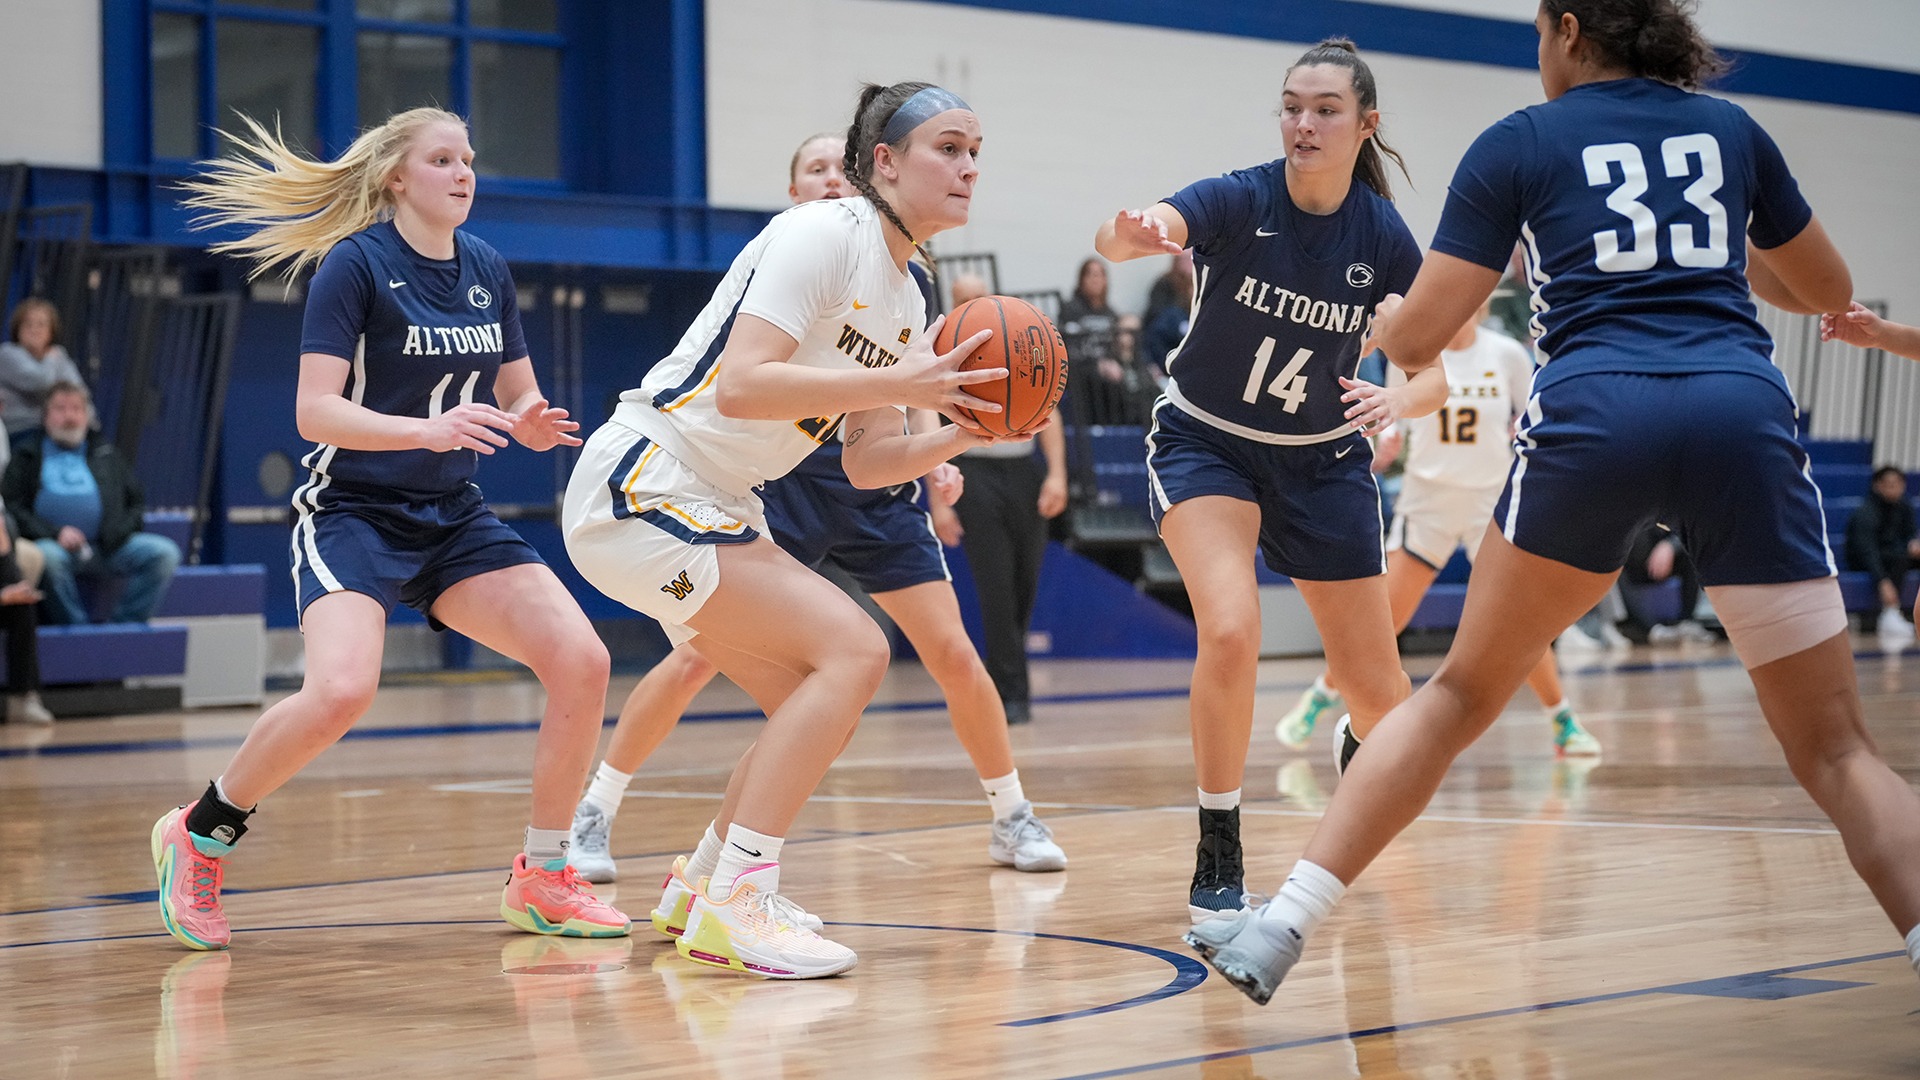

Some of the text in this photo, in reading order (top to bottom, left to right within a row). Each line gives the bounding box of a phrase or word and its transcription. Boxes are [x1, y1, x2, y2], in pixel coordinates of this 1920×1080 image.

[1582, 133, 1729, 272] 33
[1234, 275, 1365, 333] ALTOONA
[402, 322, 504, 356] ALTOONA
[1242, 336, 1314, 414] 14
[1438, 406, 1478, 444] 12
[660, 569, 695, 601] W
